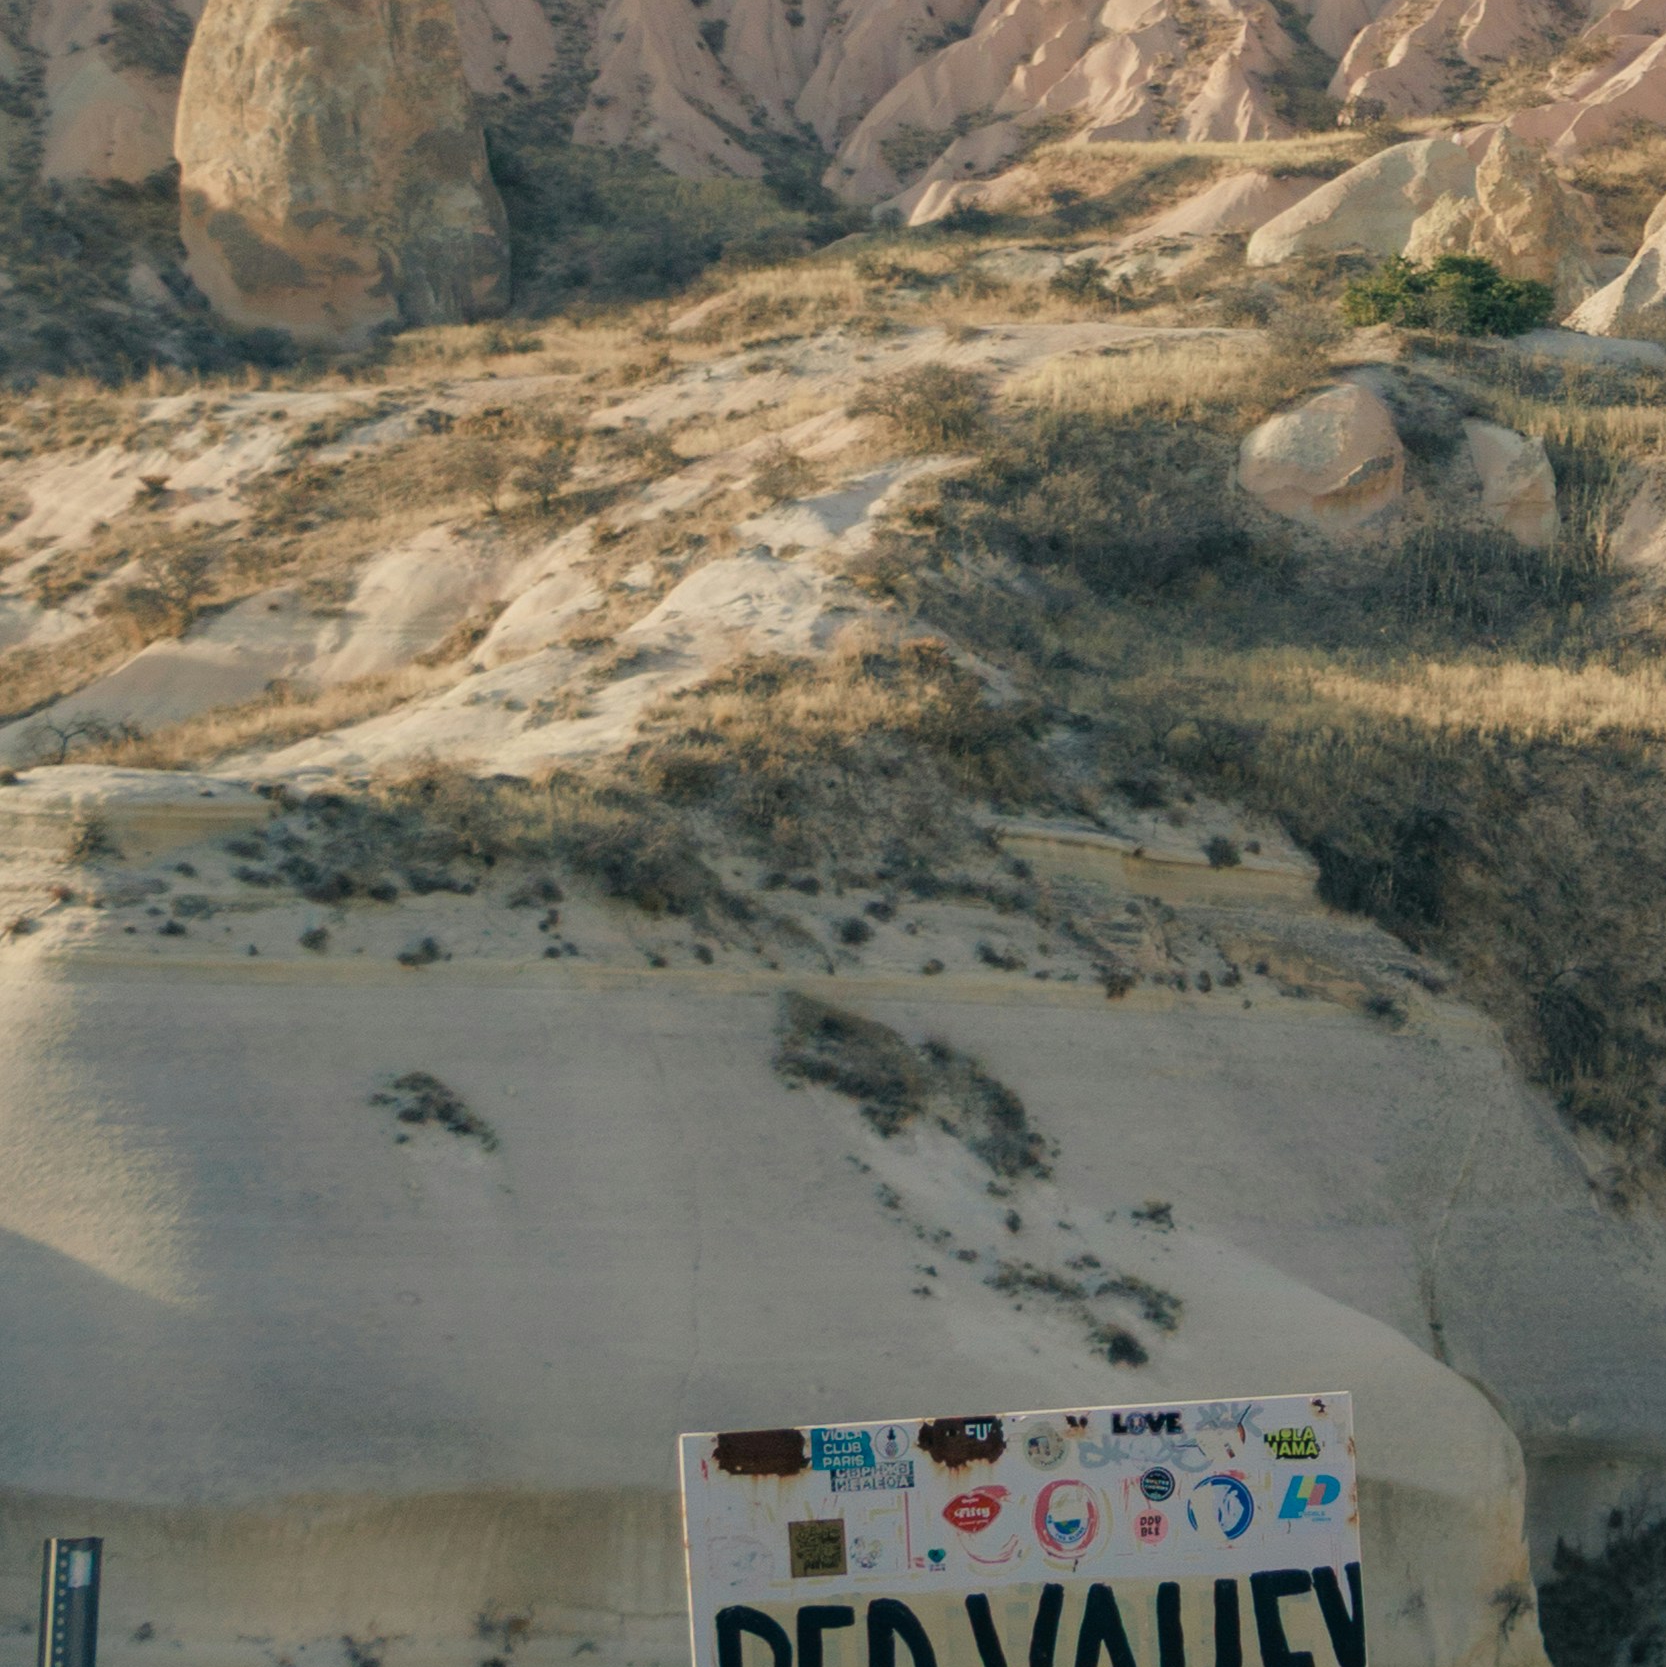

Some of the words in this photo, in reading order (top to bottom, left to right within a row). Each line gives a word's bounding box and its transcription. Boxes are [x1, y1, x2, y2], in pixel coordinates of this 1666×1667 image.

[1111, 1411, 1183, 1436] LOVE
[1266, 1426, 1315, 1441] HOLA
[823, 1441, 862, 1455] CLUB
[822, 1454, 865, 1468] PARIS
